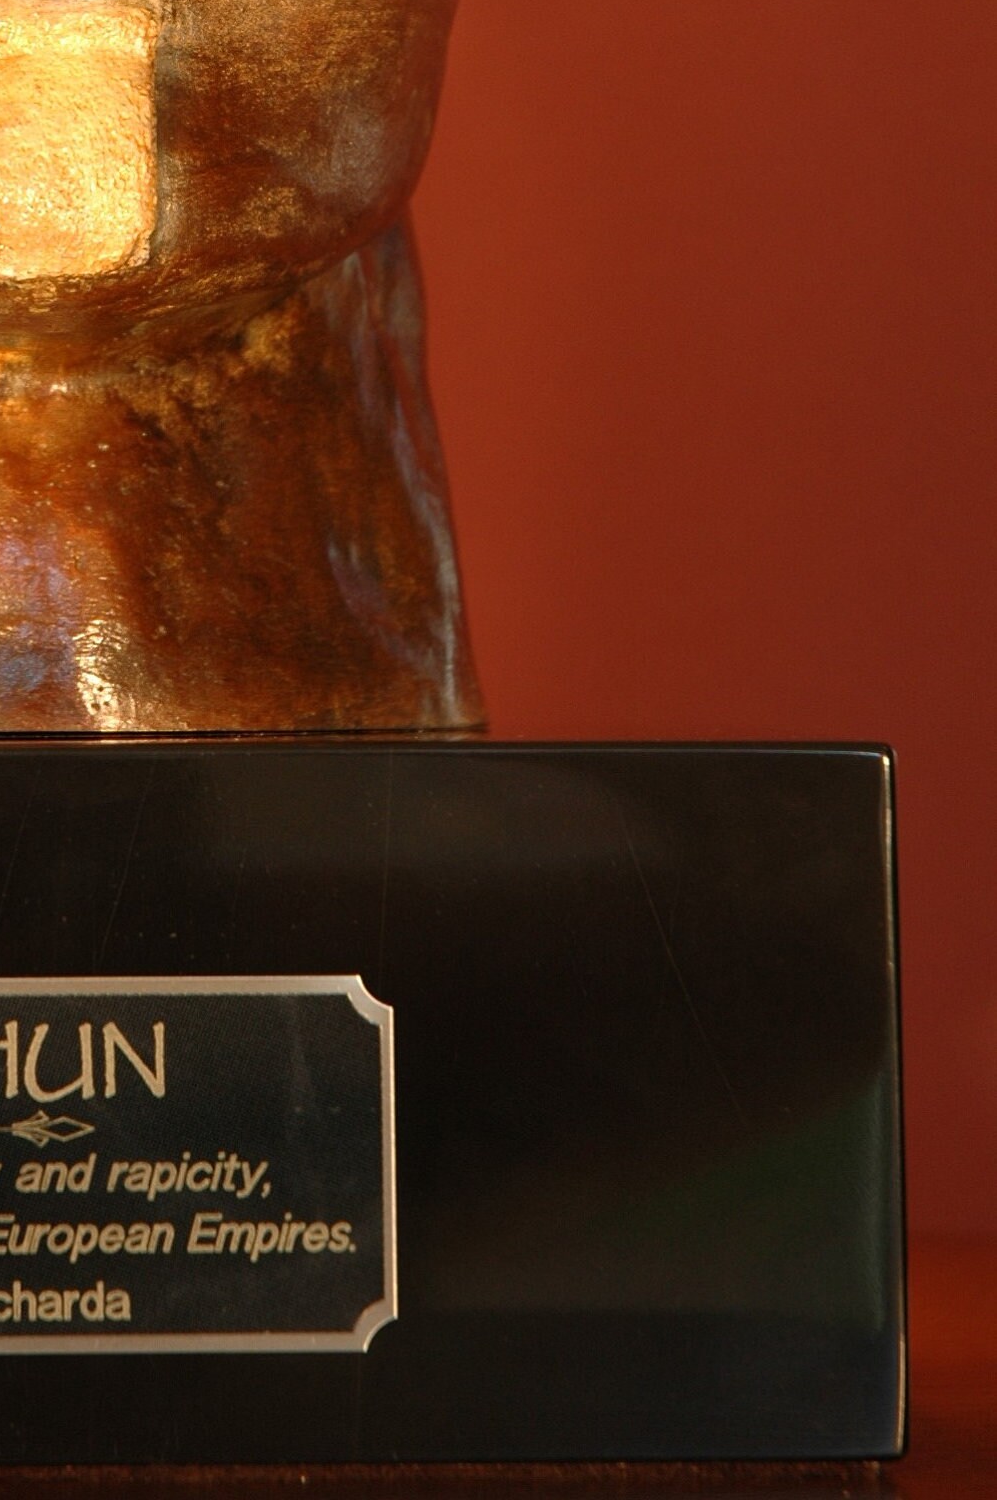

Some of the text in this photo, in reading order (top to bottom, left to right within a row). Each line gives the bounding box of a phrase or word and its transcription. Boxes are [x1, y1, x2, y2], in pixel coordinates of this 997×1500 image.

[16, 1153, 96, 1193] and
[107, 1154, 271, 1200] rapicity,
[187, 1214, 357, 1262] Empires.
